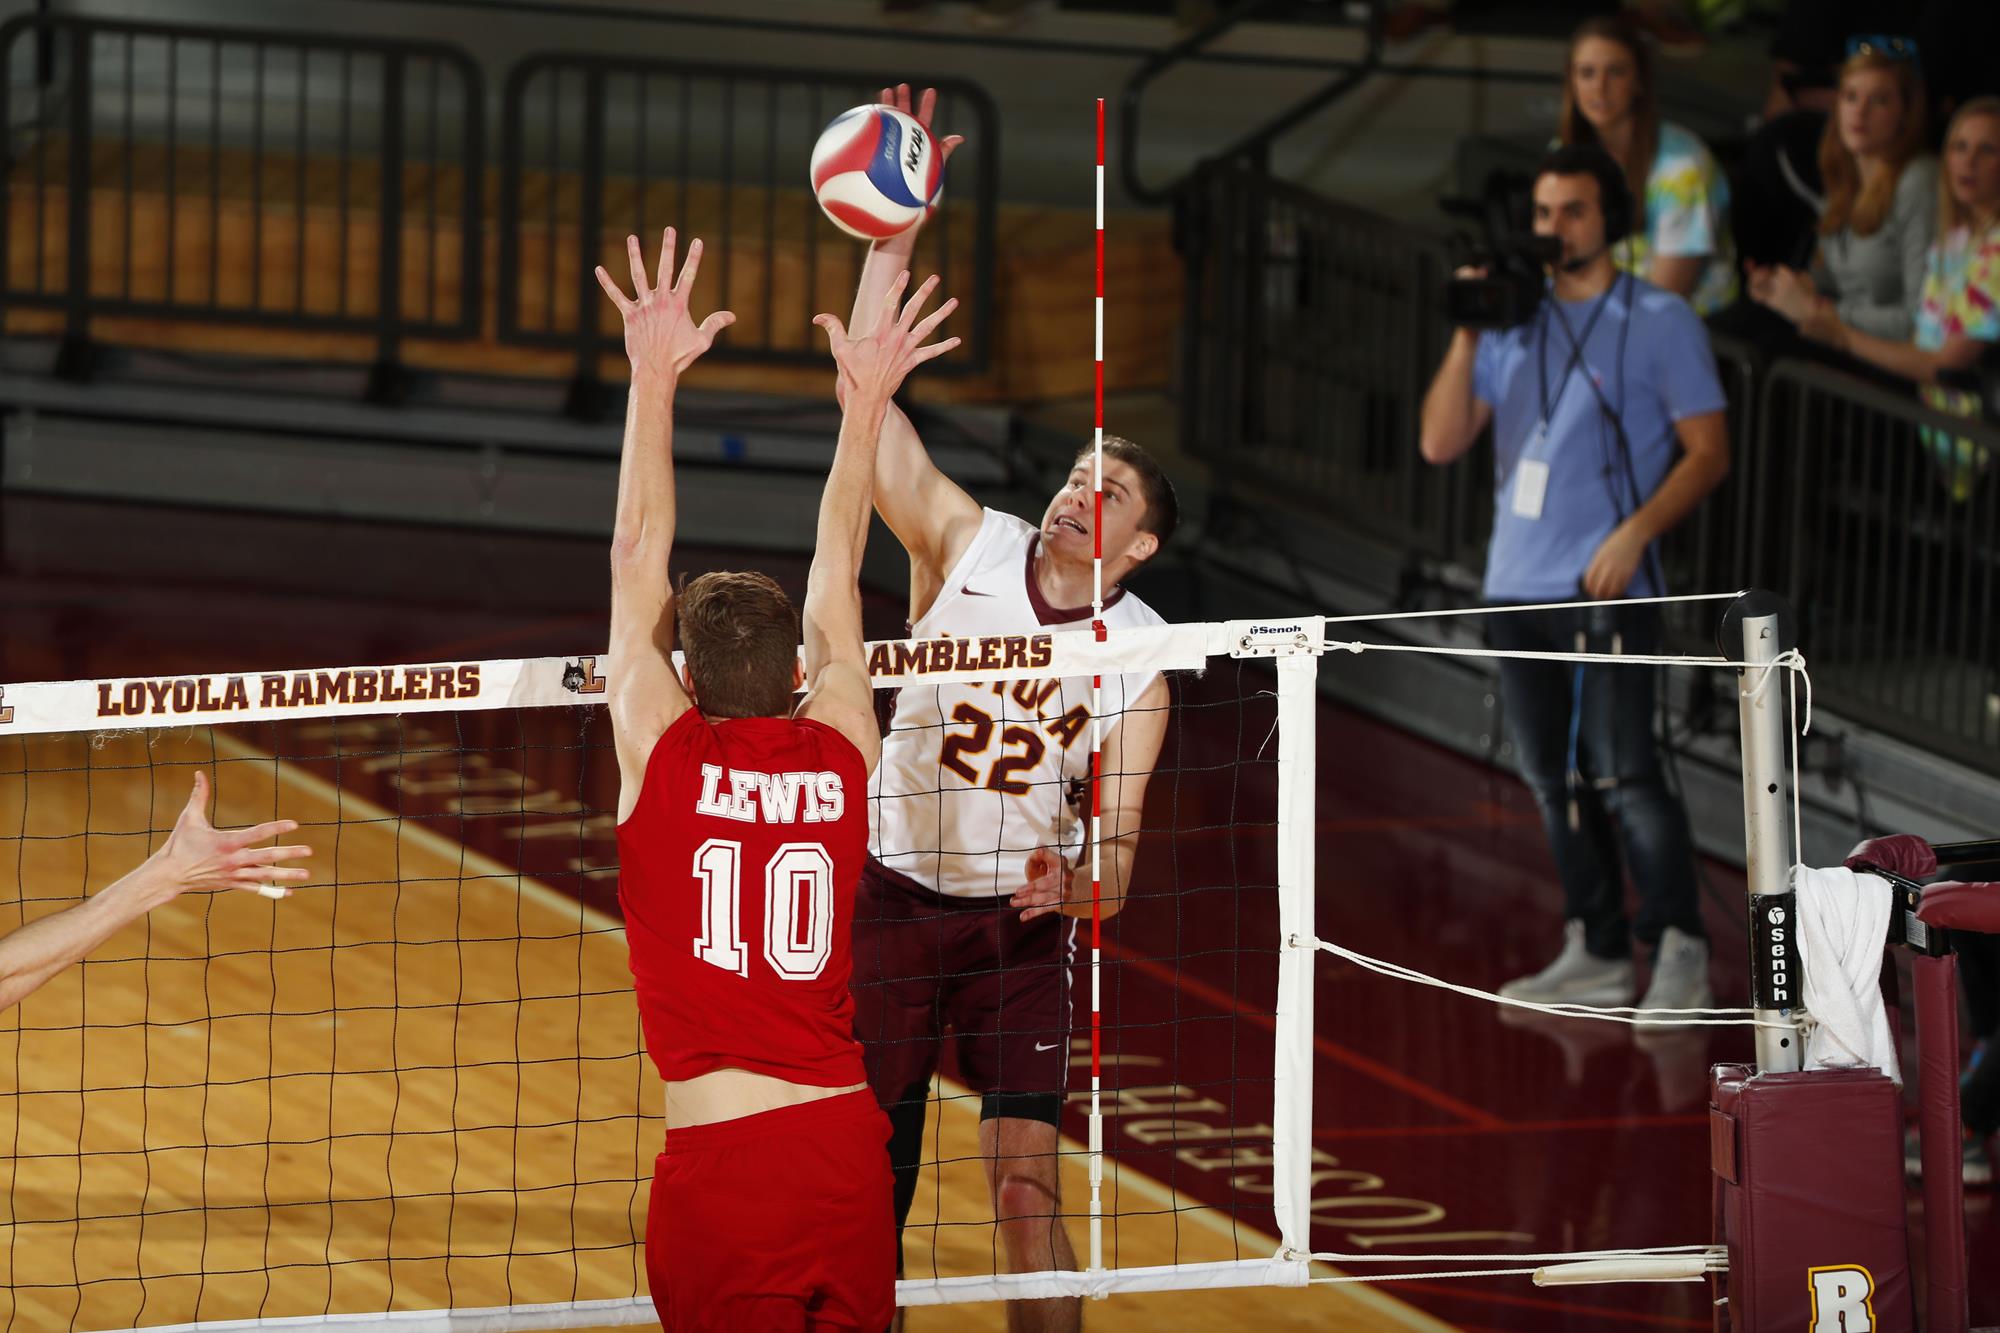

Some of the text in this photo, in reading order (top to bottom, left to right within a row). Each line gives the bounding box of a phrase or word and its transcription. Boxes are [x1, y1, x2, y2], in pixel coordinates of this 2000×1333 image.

[905, 127, 923, 173] NCAA
[869, 634, 1053, 677] AMBLERS
[1259, 625, 1302, 634] Senoh
[97, 664, 481, 717] LOYOLA RAMBLERS
[938, 701, 1046, 797] 22
[696, 763, 844, 824] LEWIS
[693, 838, 834, 981] 10
[1808, 1264, 1876, 1333] R
